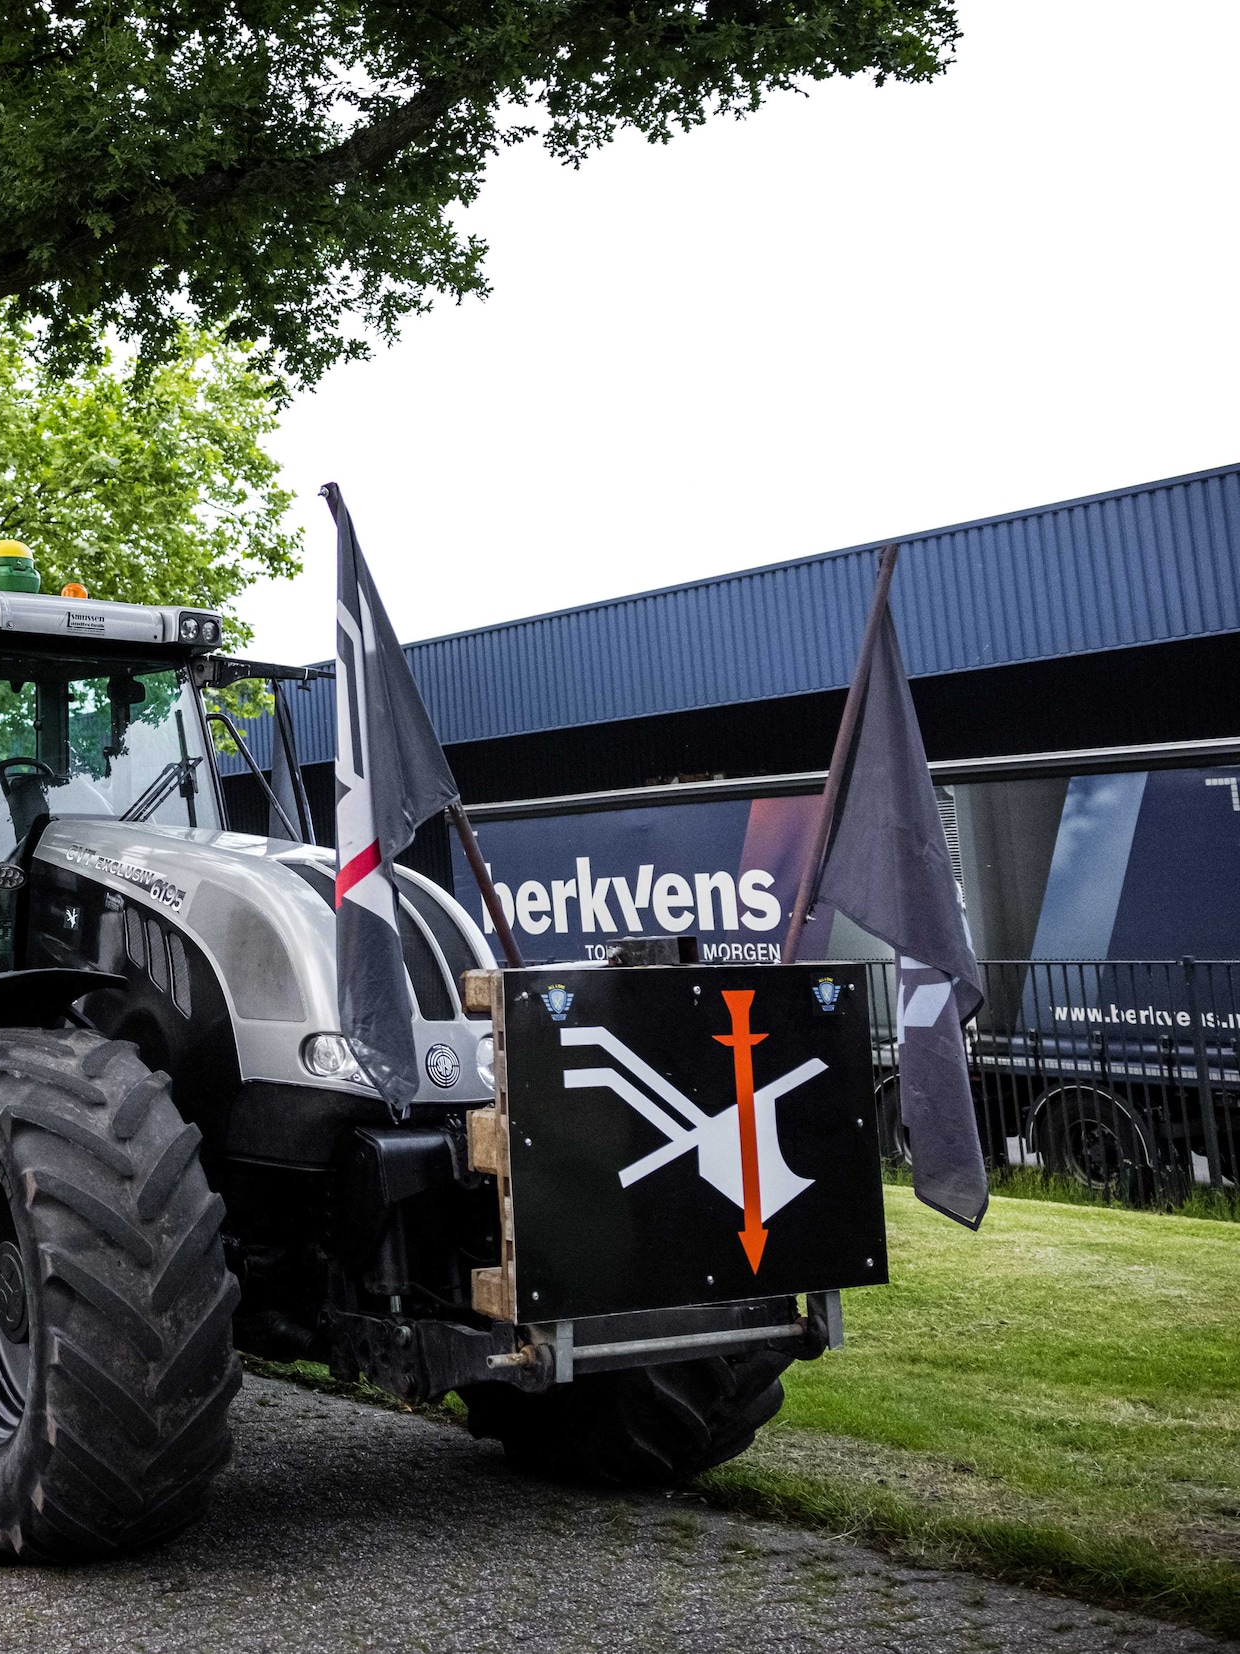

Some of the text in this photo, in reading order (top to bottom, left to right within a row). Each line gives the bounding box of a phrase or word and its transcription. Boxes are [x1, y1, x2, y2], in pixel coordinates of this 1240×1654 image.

[66, 844, 187, 912] CVT EXCLUSIV 6195
[481, 856, 782, 935] berkvens
[703, 943, 781, 961] MORGEN
